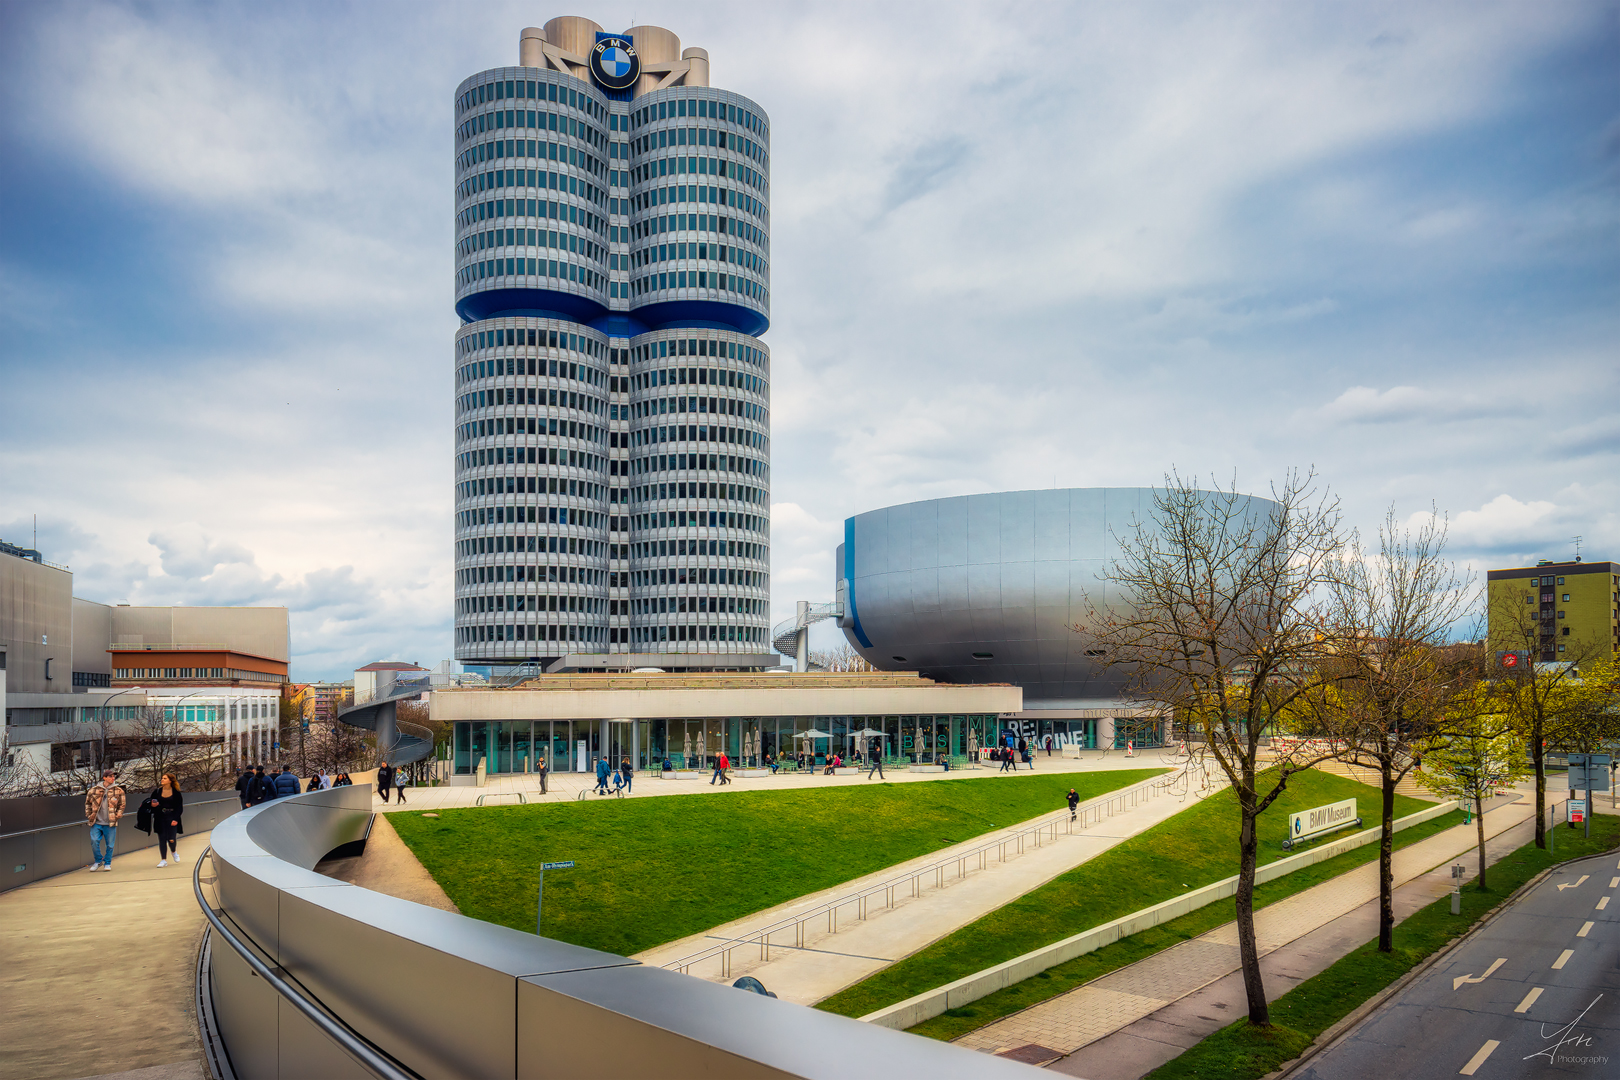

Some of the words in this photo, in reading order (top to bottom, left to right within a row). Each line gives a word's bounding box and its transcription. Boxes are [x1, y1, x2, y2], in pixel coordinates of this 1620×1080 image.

[595, 39, 636, 57] BMW
[1083, 708, 1134, 718] museum
[1008, 720, 1035, 737] RE:
[1014, 730, 1083, 749] IAGINE
[1309, 808, 1327, 829] BMW
[1327, 806, 1352, 823] Museum
